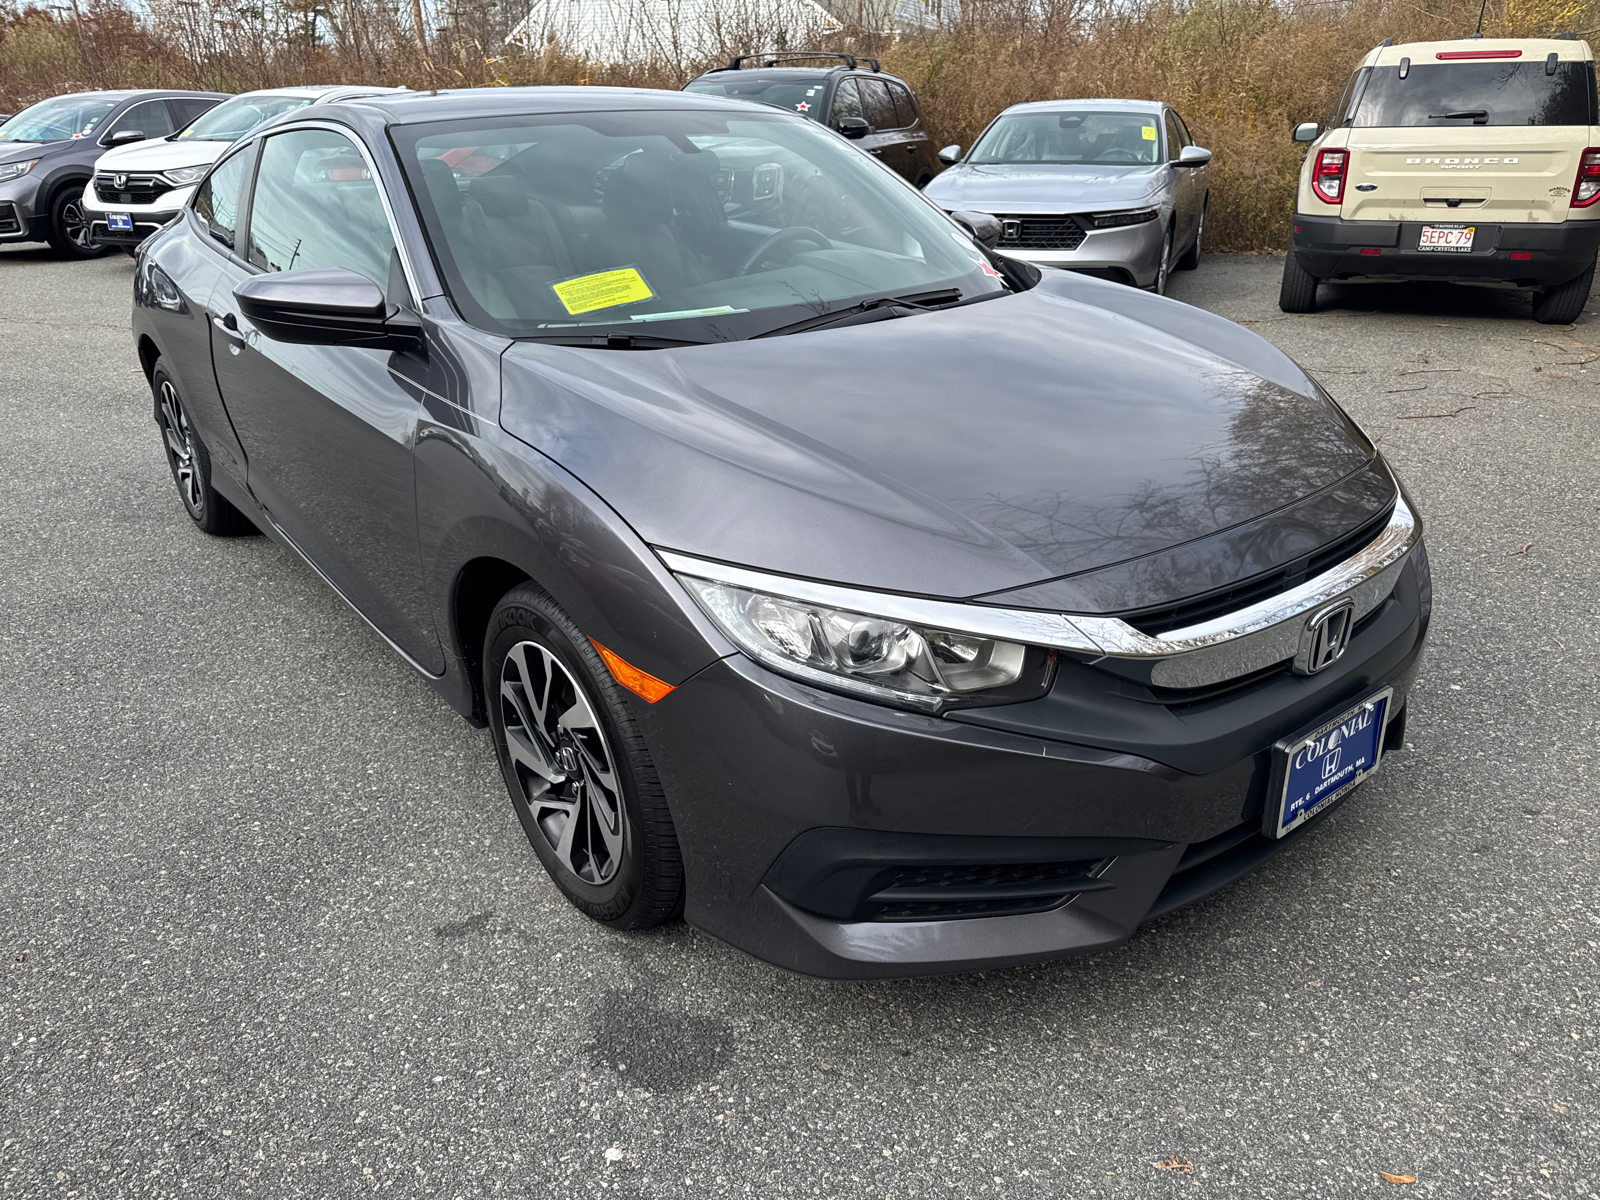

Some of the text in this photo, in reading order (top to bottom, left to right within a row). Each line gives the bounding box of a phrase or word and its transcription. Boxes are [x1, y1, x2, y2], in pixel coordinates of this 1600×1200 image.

[1406, 157, 1519, 165] BRONCO
[1422, 231, 1472, 245] 5EPC 79
[1295, 711, 1372, 770] COLONIAL
[1315, 709, 1355, 738] DARTMOUTH
[1290, 756, 1366, 812] RTE. 6 DARTMOUTH, MA
[1303, 780, 1356, 821] COLONIAL HONDA
